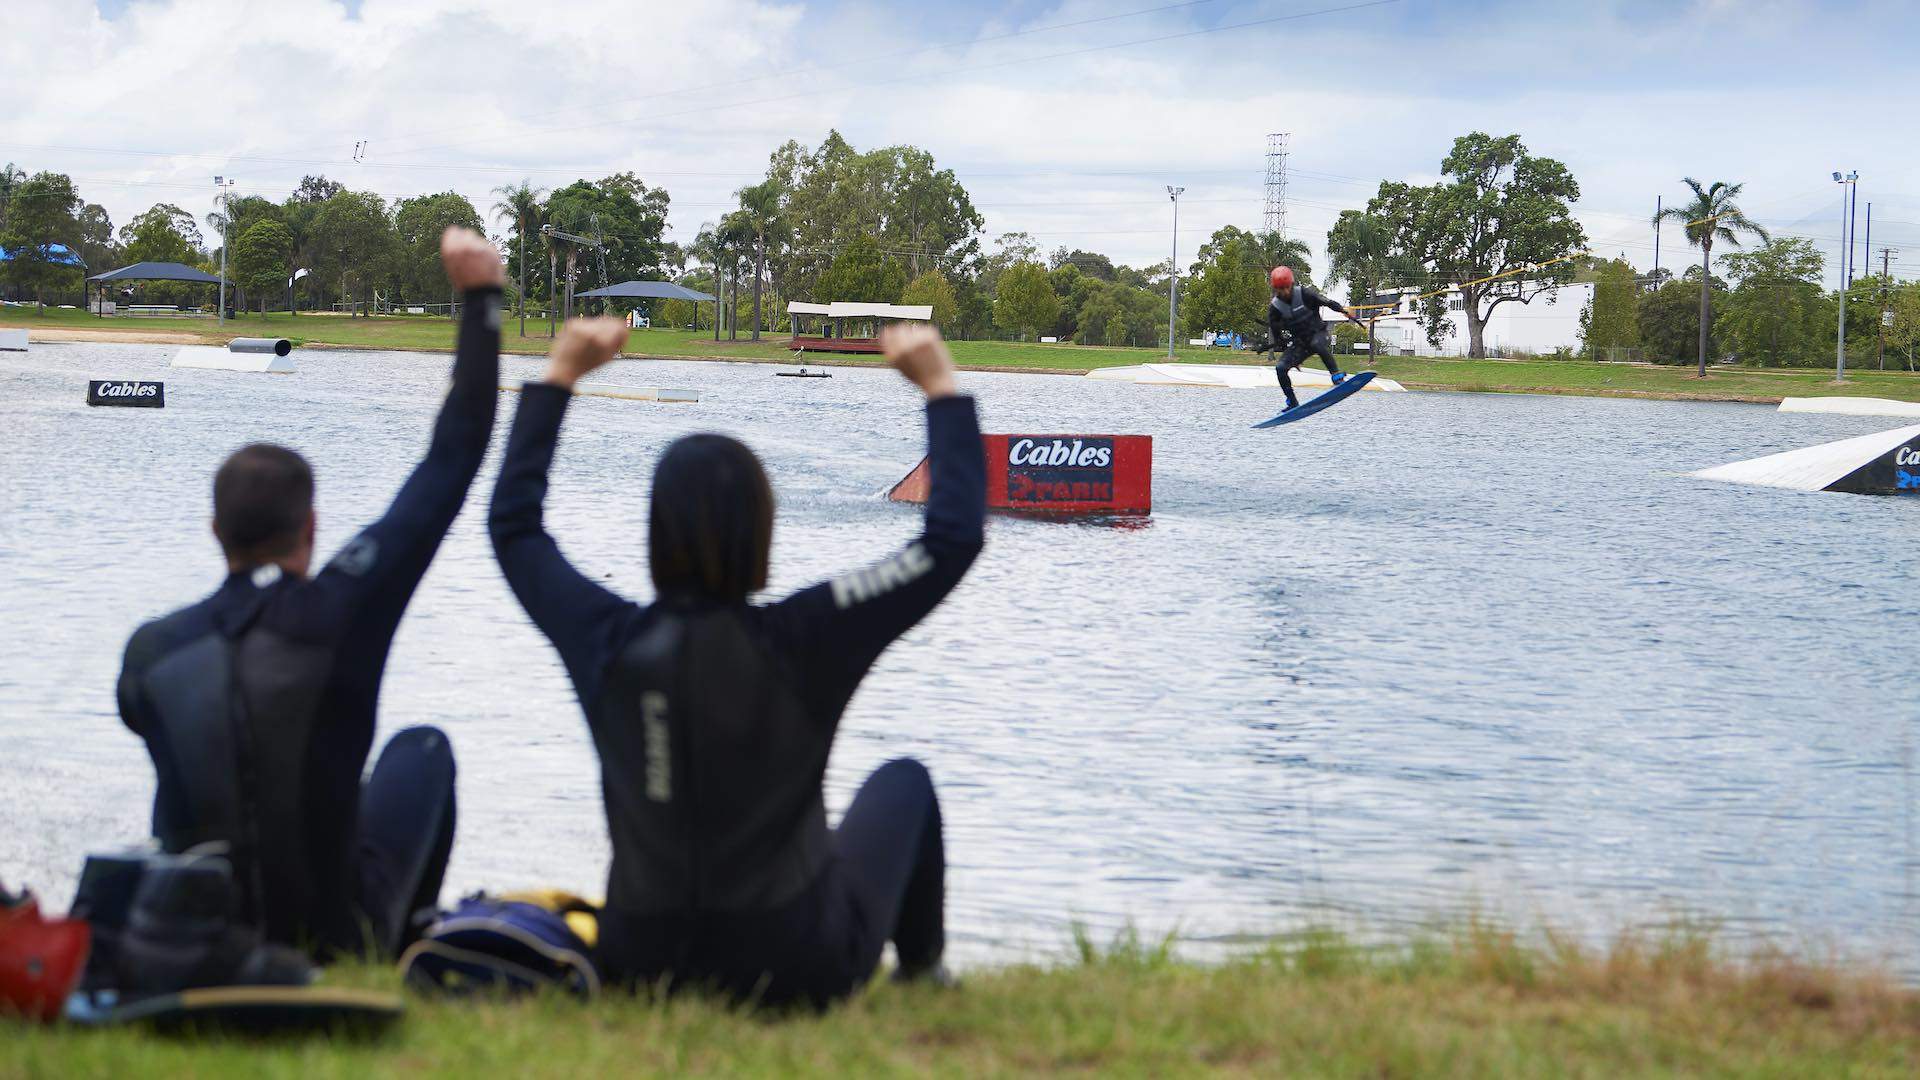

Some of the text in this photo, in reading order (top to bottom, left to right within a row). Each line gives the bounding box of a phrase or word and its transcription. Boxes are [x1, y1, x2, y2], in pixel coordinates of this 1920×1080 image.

[97, 382, 157, 397] Cables
[1008, 439, 1112, 467] Cables
[830, 541, 935, 609] HIRE
